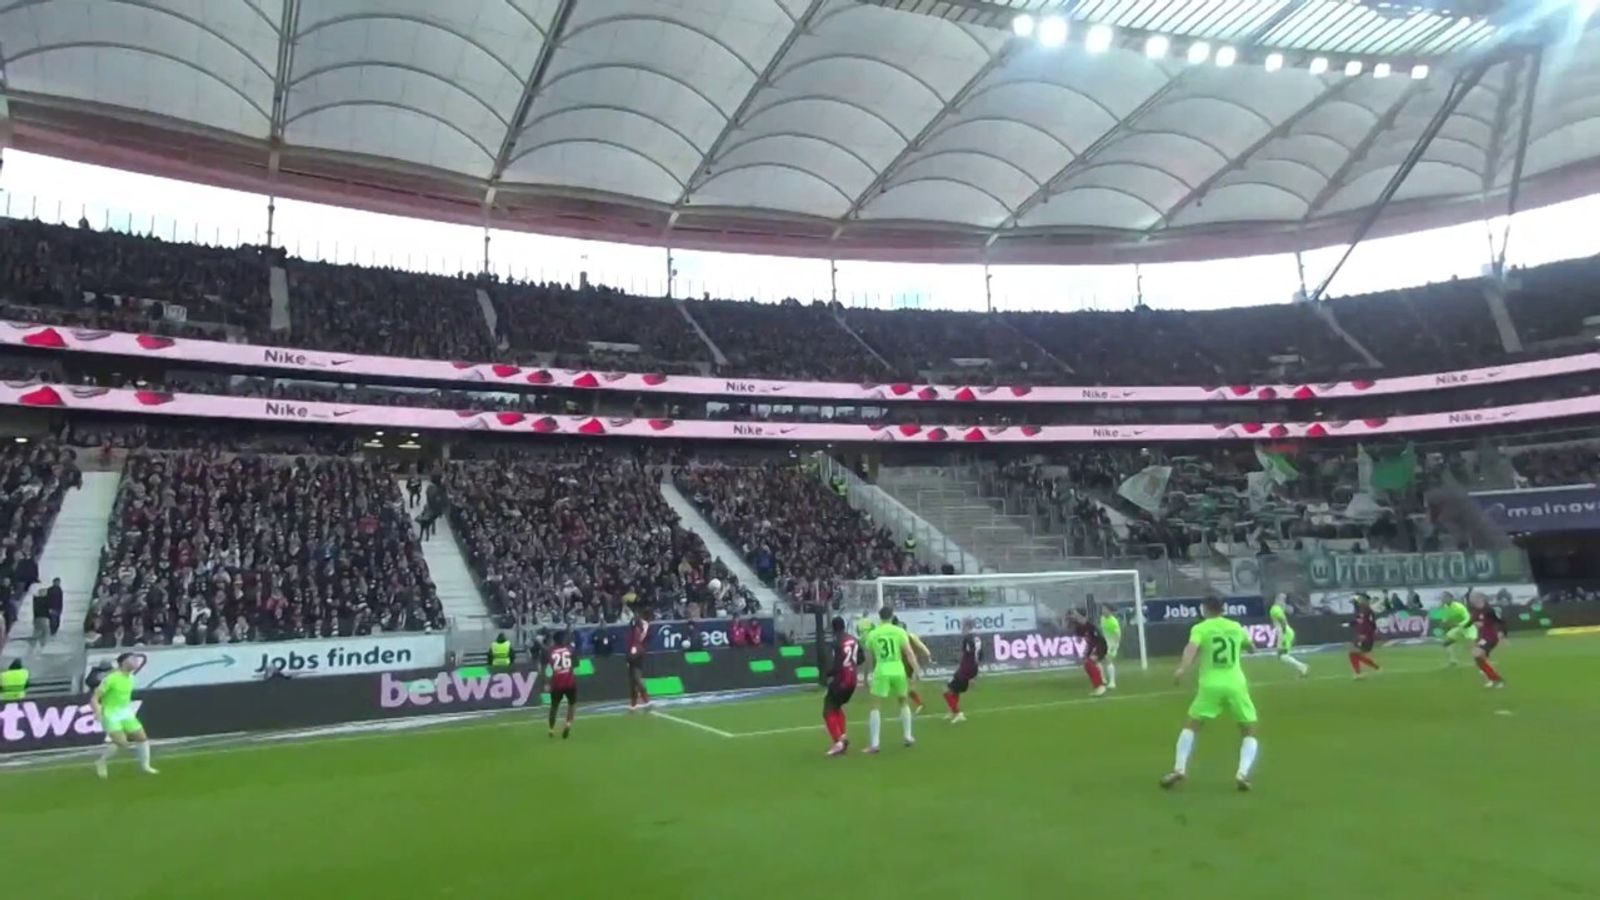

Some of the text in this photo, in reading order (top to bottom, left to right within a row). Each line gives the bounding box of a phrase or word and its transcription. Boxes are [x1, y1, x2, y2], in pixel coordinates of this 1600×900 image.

[264, 349, 306, 365] Nike
[725, 381, 756, 393] Nike
[1435, 374, 1469, 385] Nike
[1081, 389, 1109, 400] Nike
[265, 401, 308, 417] Nike
[1448, 413, 1483, 424] Nike
[733, 424, 763, 436] Nike
[1092, 428, 1119, 438] Nike
[1507, 501, 1600, 517] mainov
[1163, 604, 1198, 618] Jobs
[944, 613, 1005, 630] ineed
[1374, 613, 1430, 637] etway
[878, 638, 895, 659] 31
[993, 633, 1087, 661] betway
[1211, 636, 1236, 664] 21
[255, 645, 412, 672] Jobs finden
[551, 653, 572, 670] 26
[380, 671, 538, 708] betway
[0, 700, 143, 741] twa
